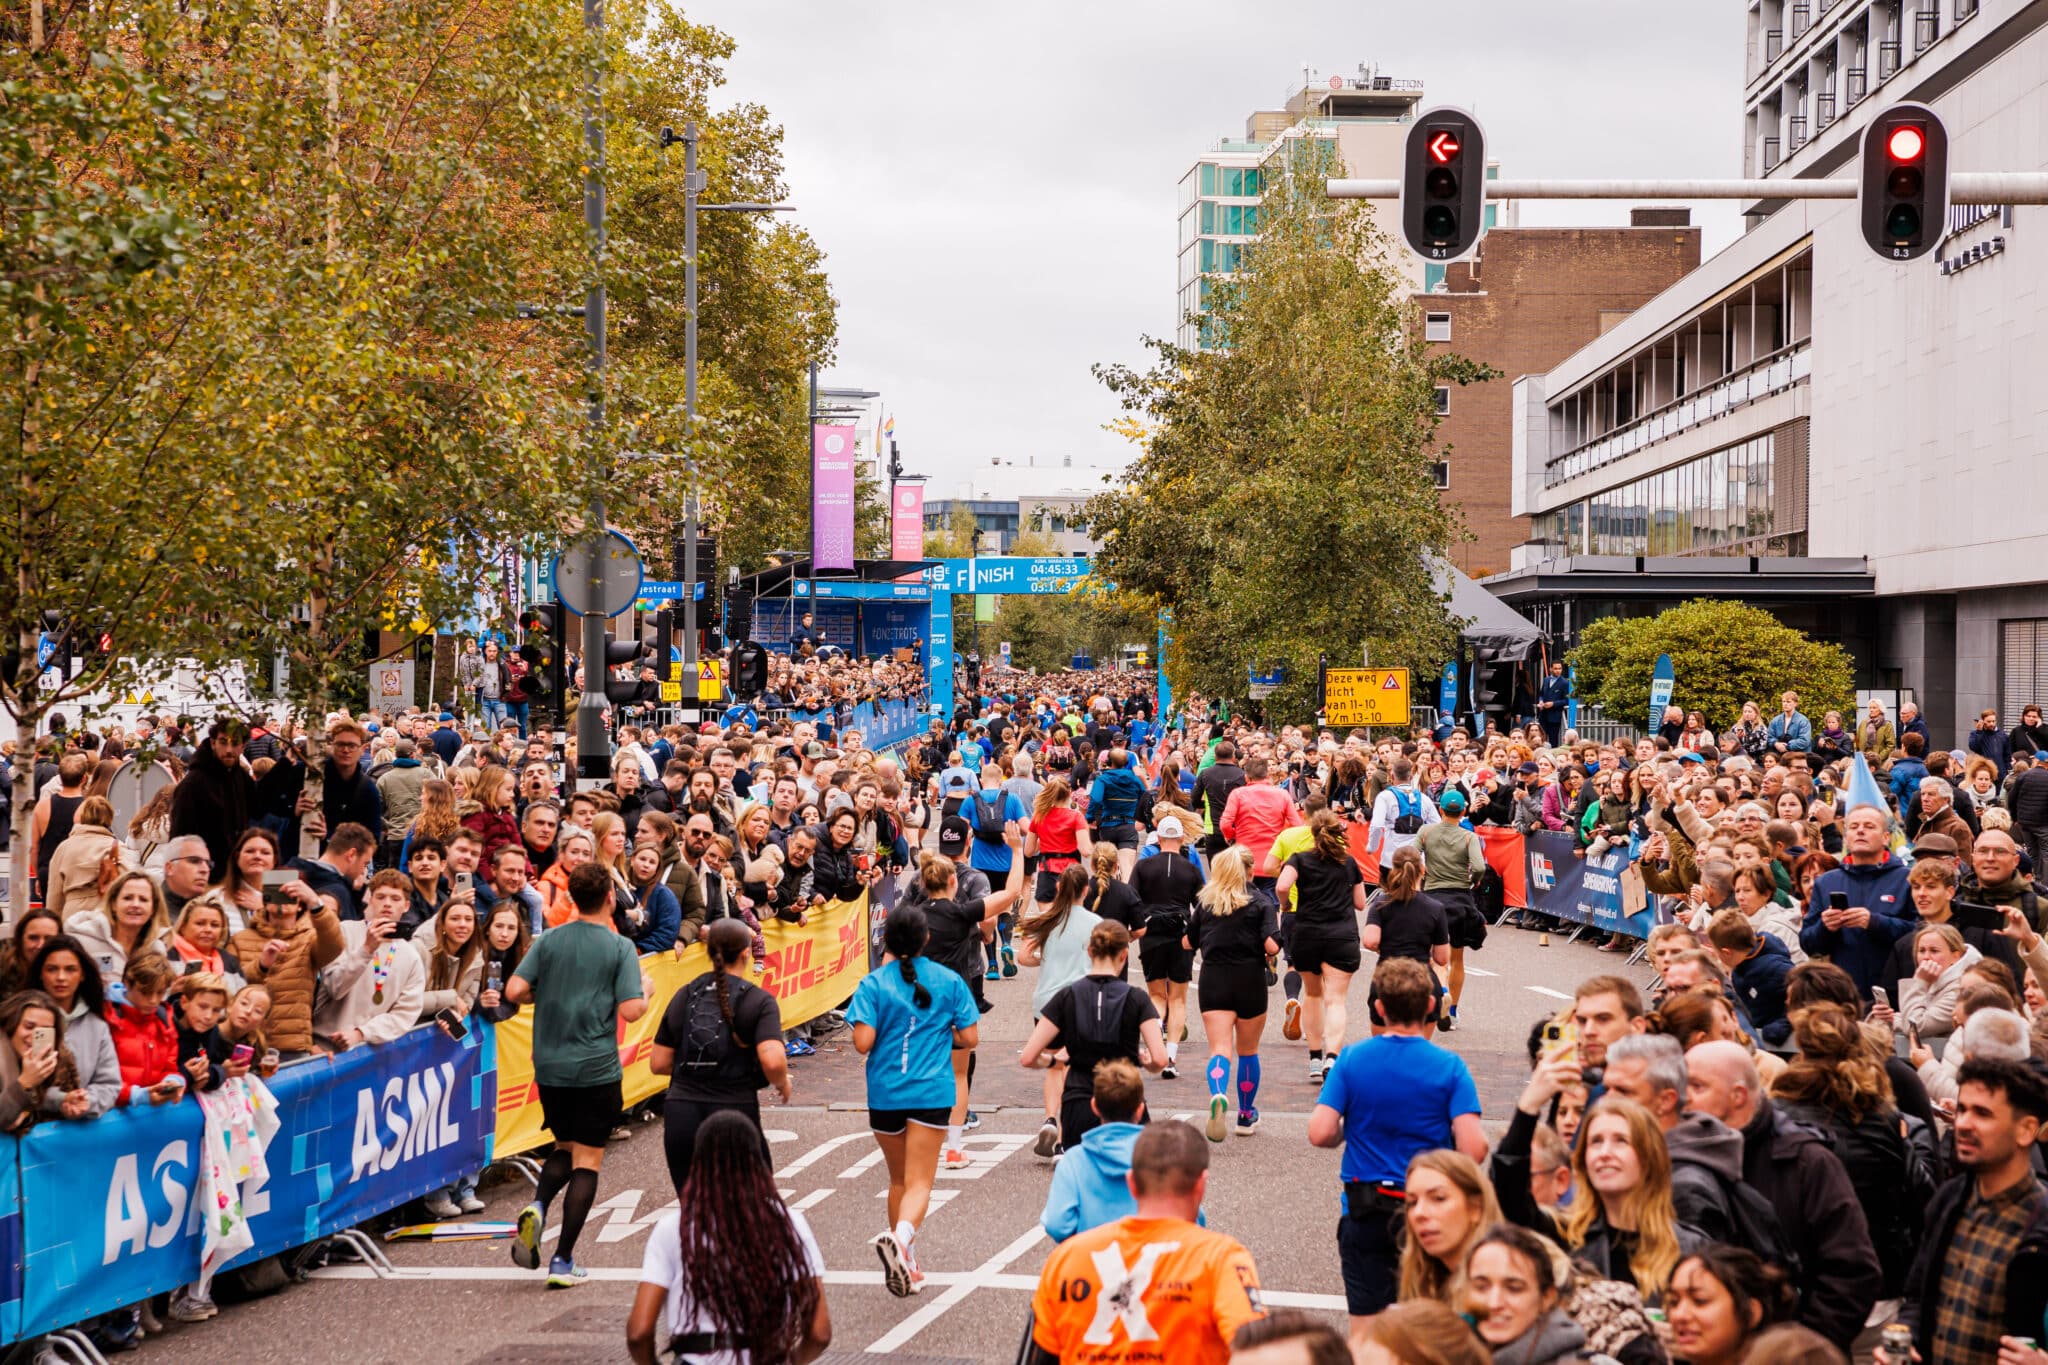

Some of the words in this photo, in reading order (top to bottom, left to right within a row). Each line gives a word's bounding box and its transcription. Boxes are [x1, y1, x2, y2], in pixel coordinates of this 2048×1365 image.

[1432, 248, 1446, 257] 9.1
[1031, 564, 1078, 575] 04:45:33
[1326, 673, 1353, 684] Deze
[1357, 674, 1377, 686] weg
[1326, 686, 1355, 697] dicht
[1327, 701, 1346, 710] van
[1350, 699, 1376, 710] 11-10
[1327, 713, 1349, 723] t/m
[1353, 712, 1382, 723] 13-10
[349, 1061, 461, 1184] ASML
